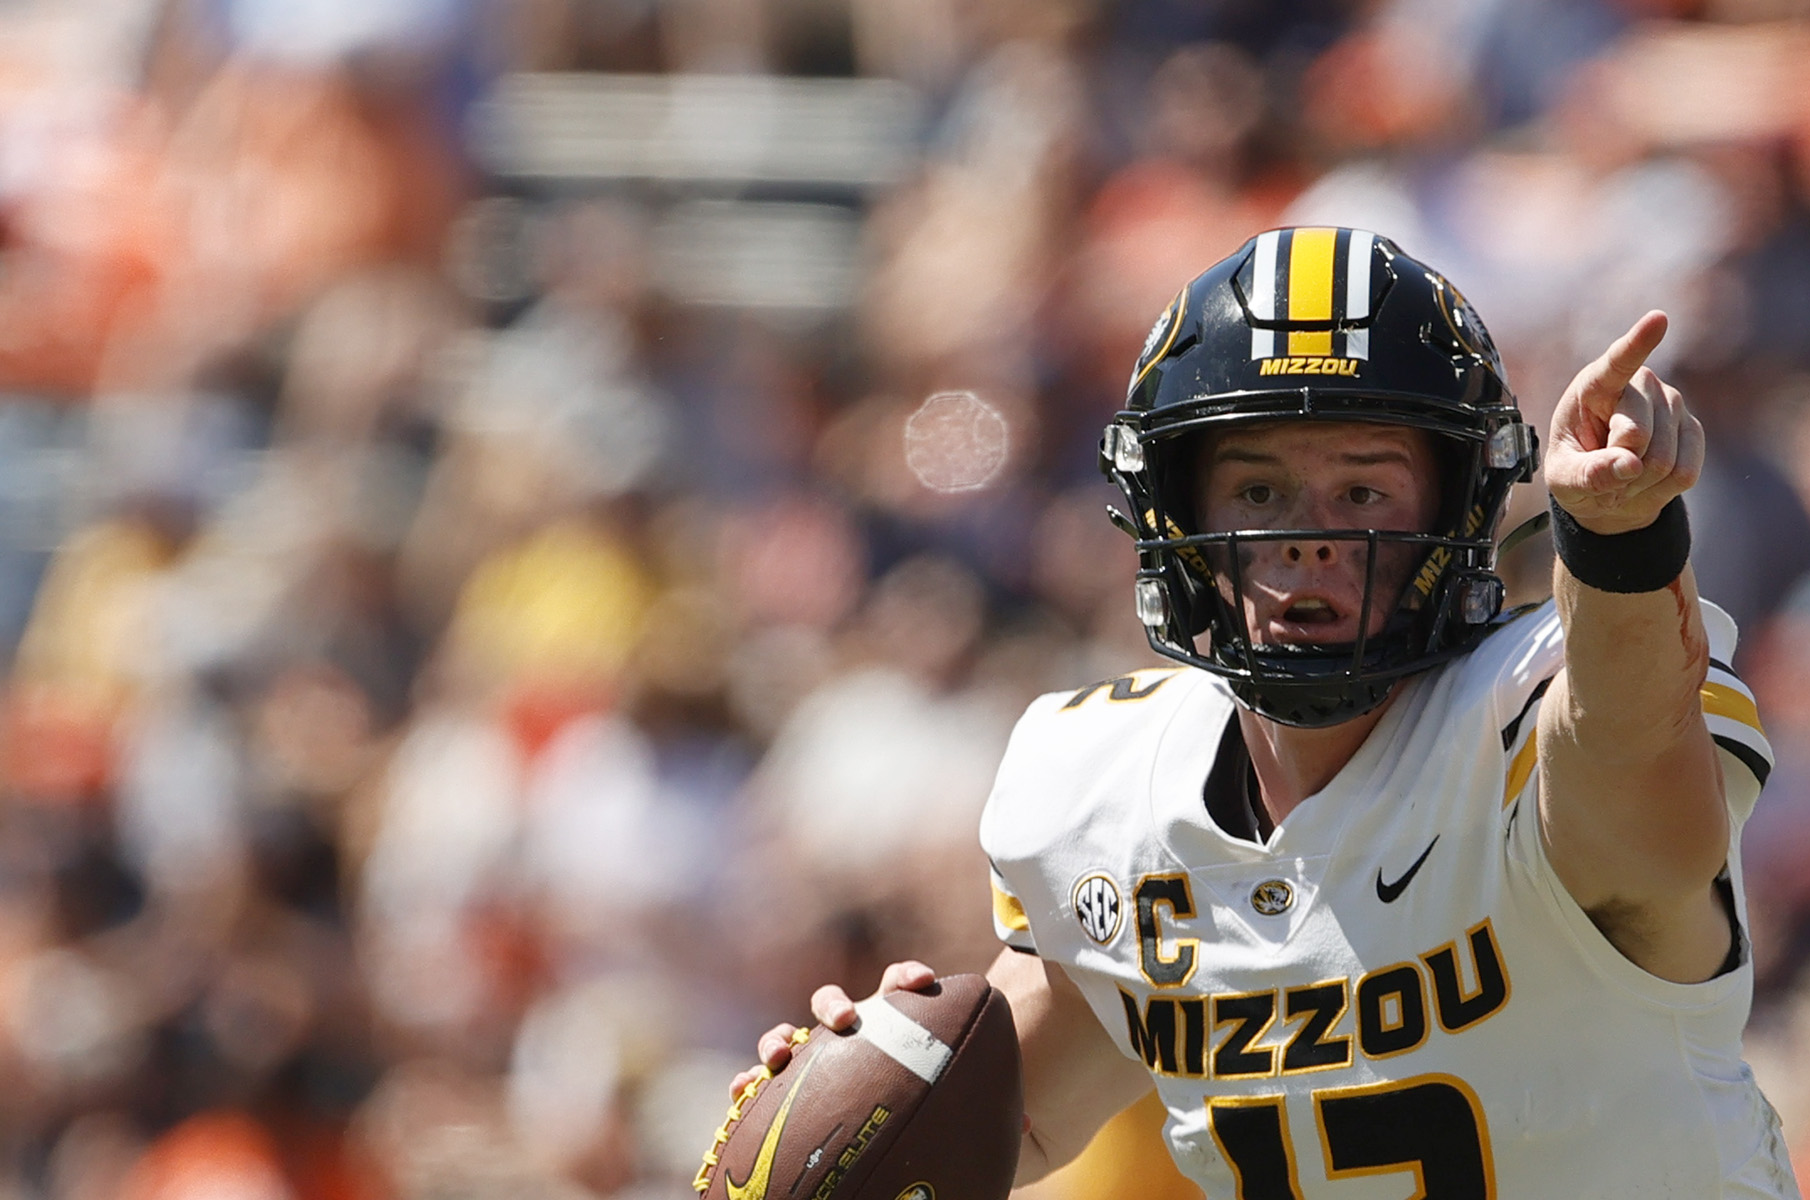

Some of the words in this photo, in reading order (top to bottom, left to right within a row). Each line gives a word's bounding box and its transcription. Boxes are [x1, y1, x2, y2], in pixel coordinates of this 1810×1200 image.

[1259, 358, 1358, 376] MIZZOU
[1075, 877, 1119, 942] SEC
[1133, 872, 1200, 989] C
[1117, 916, 1512, 1080] MIZZOU
[838, 1105, 890, 1170] ELITE
